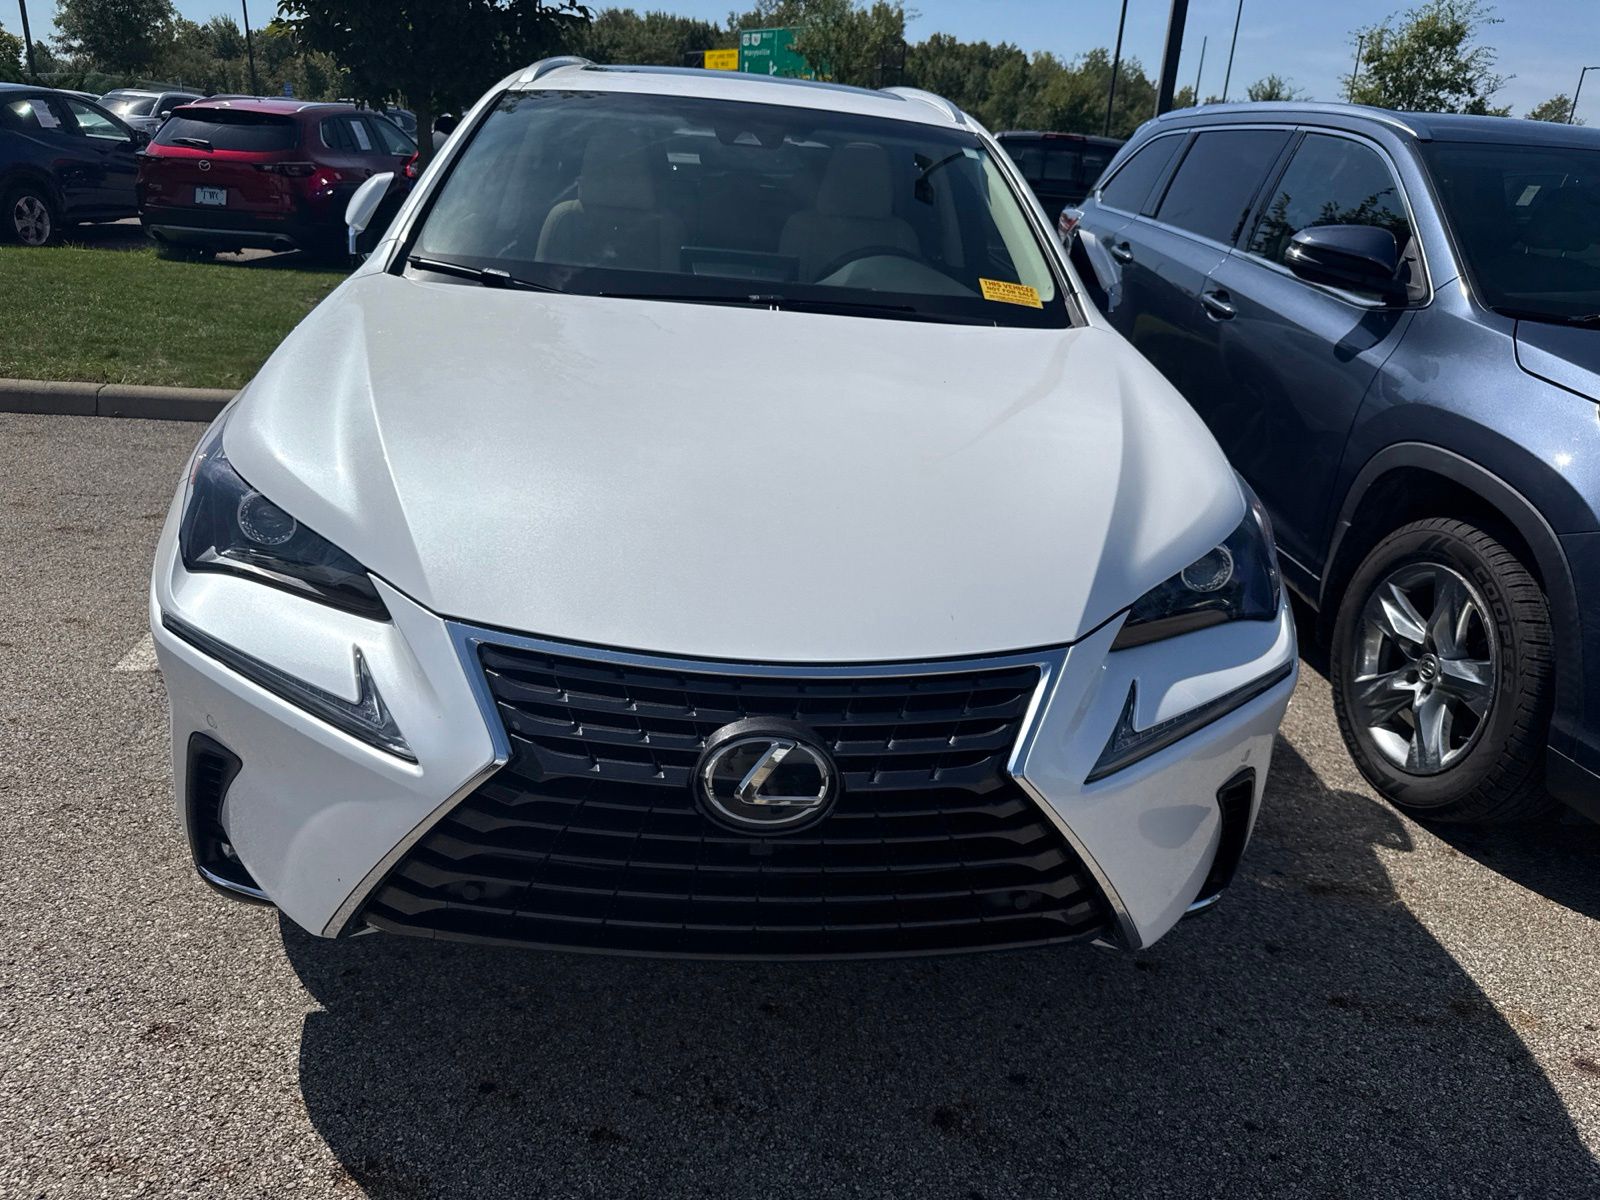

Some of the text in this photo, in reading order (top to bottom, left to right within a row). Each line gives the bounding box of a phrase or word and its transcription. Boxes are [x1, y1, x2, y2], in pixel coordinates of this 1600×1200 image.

[984, 280, 1035, 293] THIS VEHICLE
[1473, 567, 1513, 693] COOPER
